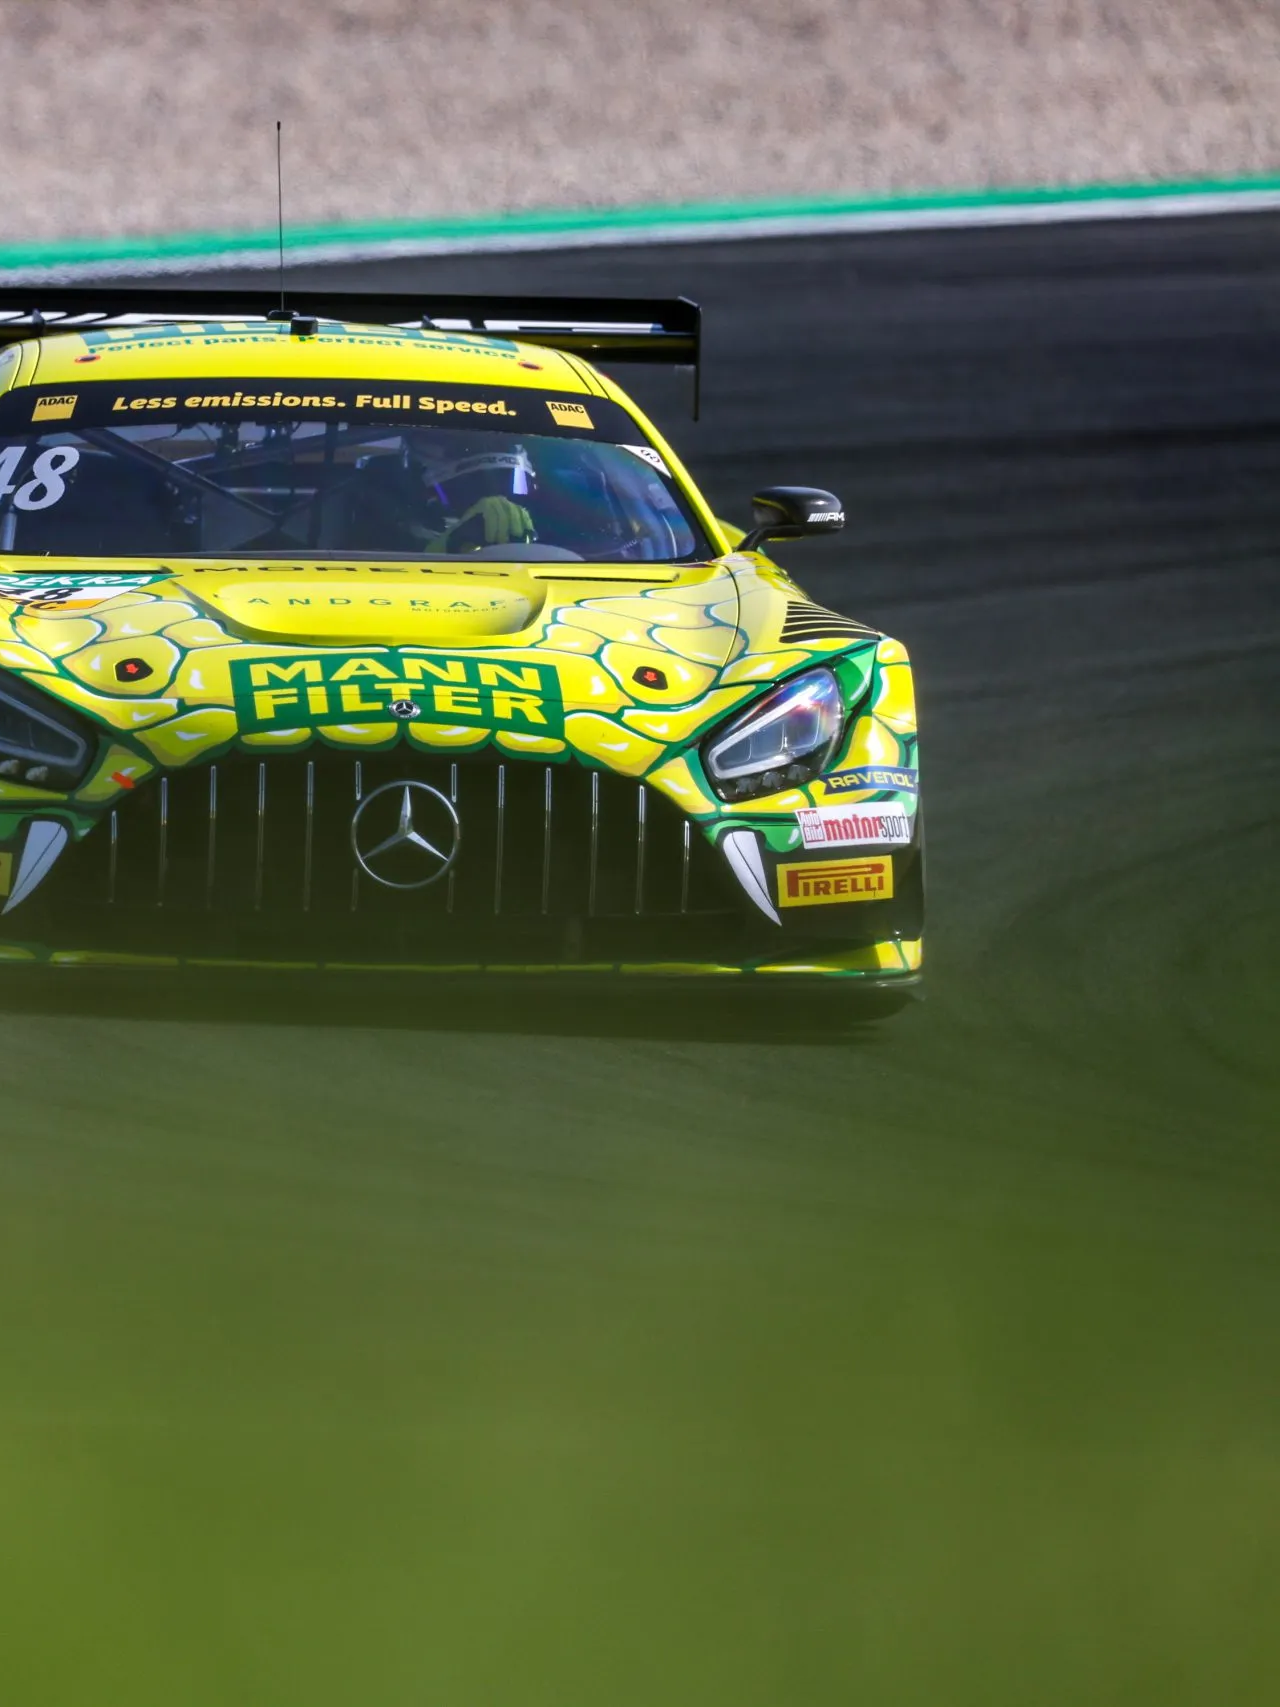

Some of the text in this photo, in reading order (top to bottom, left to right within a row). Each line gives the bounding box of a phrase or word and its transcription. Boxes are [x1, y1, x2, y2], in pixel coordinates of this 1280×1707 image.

[38, 396, 76, 407] ADAC
[112, 392, 518, 417] Less emissions. Full Speed.
[550, 402, 585, 414] ADAC
[213, 594, 506, 607] ANDGRAF
[249, 658, 542, 691] MANN
[253, 683, 549, 725] FILTER
[827, 770, 914, 788] RAVENOL
[822, 812, 909, 842] motorsport
[786, 862, 885, 899] PIRELLI
